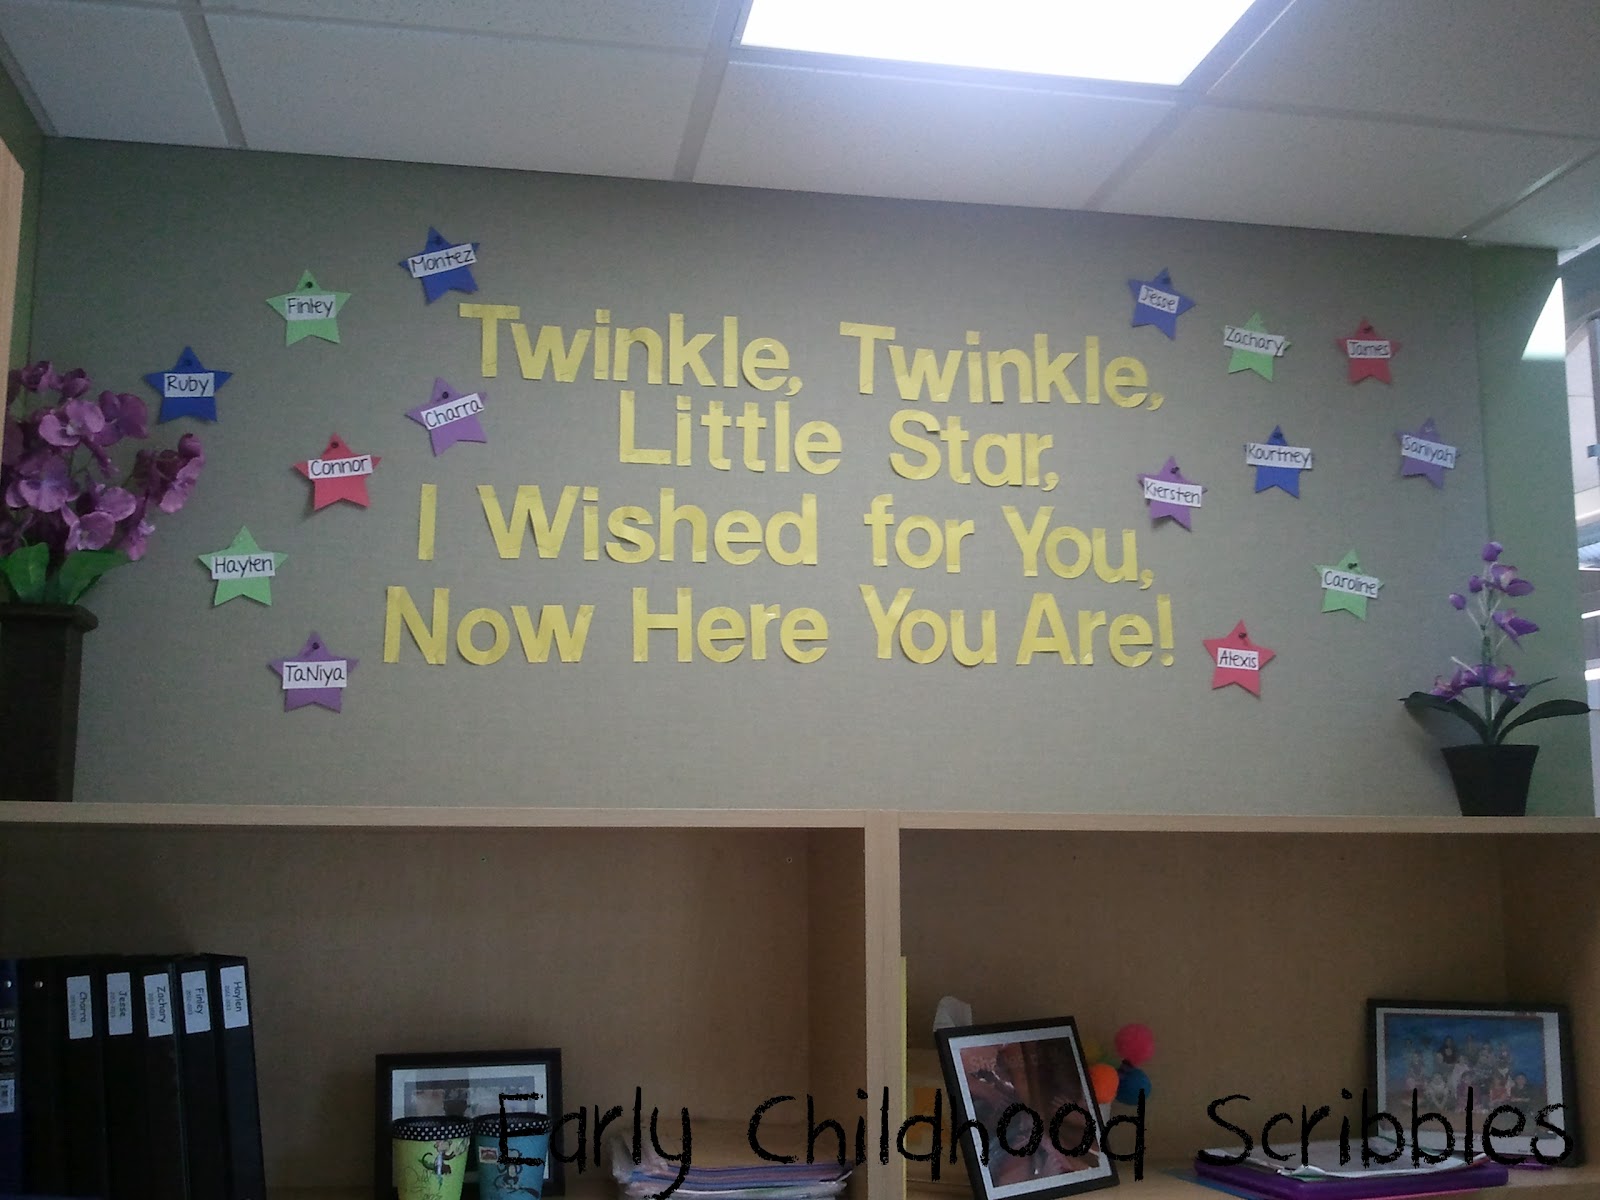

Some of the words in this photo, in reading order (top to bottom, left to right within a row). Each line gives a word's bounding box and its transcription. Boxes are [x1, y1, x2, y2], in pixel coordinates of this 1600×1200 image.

[410, 247, 474, 273] Montez
[287, 297, 334, 318] Finley
[1139, 286, 1176, 312] Jesse
[1225, 327, 1283, 354] Zachary
[1349, 340, 1390, 357] James
[459, 303, 803, 396] Twinkle,
[839, 321, 1165, 411] Twinkle,
[167, 375, 209, 395] Ruby
[424, 400, 482, 428] Charra
[620, 390, 842, 475] Little
[889, 409, 1060, 492] Star,
[310, 455, 369, 477] Connor
[1248, 444, 1312, 469] Kourtney
[1145, 483, 1200, 506] Kiersten
[418, 485, 437, 561] I
[477, 484, 817, 565] Wished
[863, 494, 975, 574] for
[1002, 505, 1154, 590] You,
[1324, 571, 1377, 596] Caroline
[383, 586, 596, 665] Now
[633, 587, 829, 664] Here
[859, 584, 998, 667] You
[1016, 592, 1175, 668] Are!
[1220, 650, 1257, 669] Alexis
[284, 664, 345, 684] TaNiya
[79, 991, 88, 1024] Charra
[118, 991, 127, 1018] Jesse
[157, 985, 167, 1024] Zachary
[195, 987, 205, 1015] Finley
[233, 981, 242, 1013] Haylen
